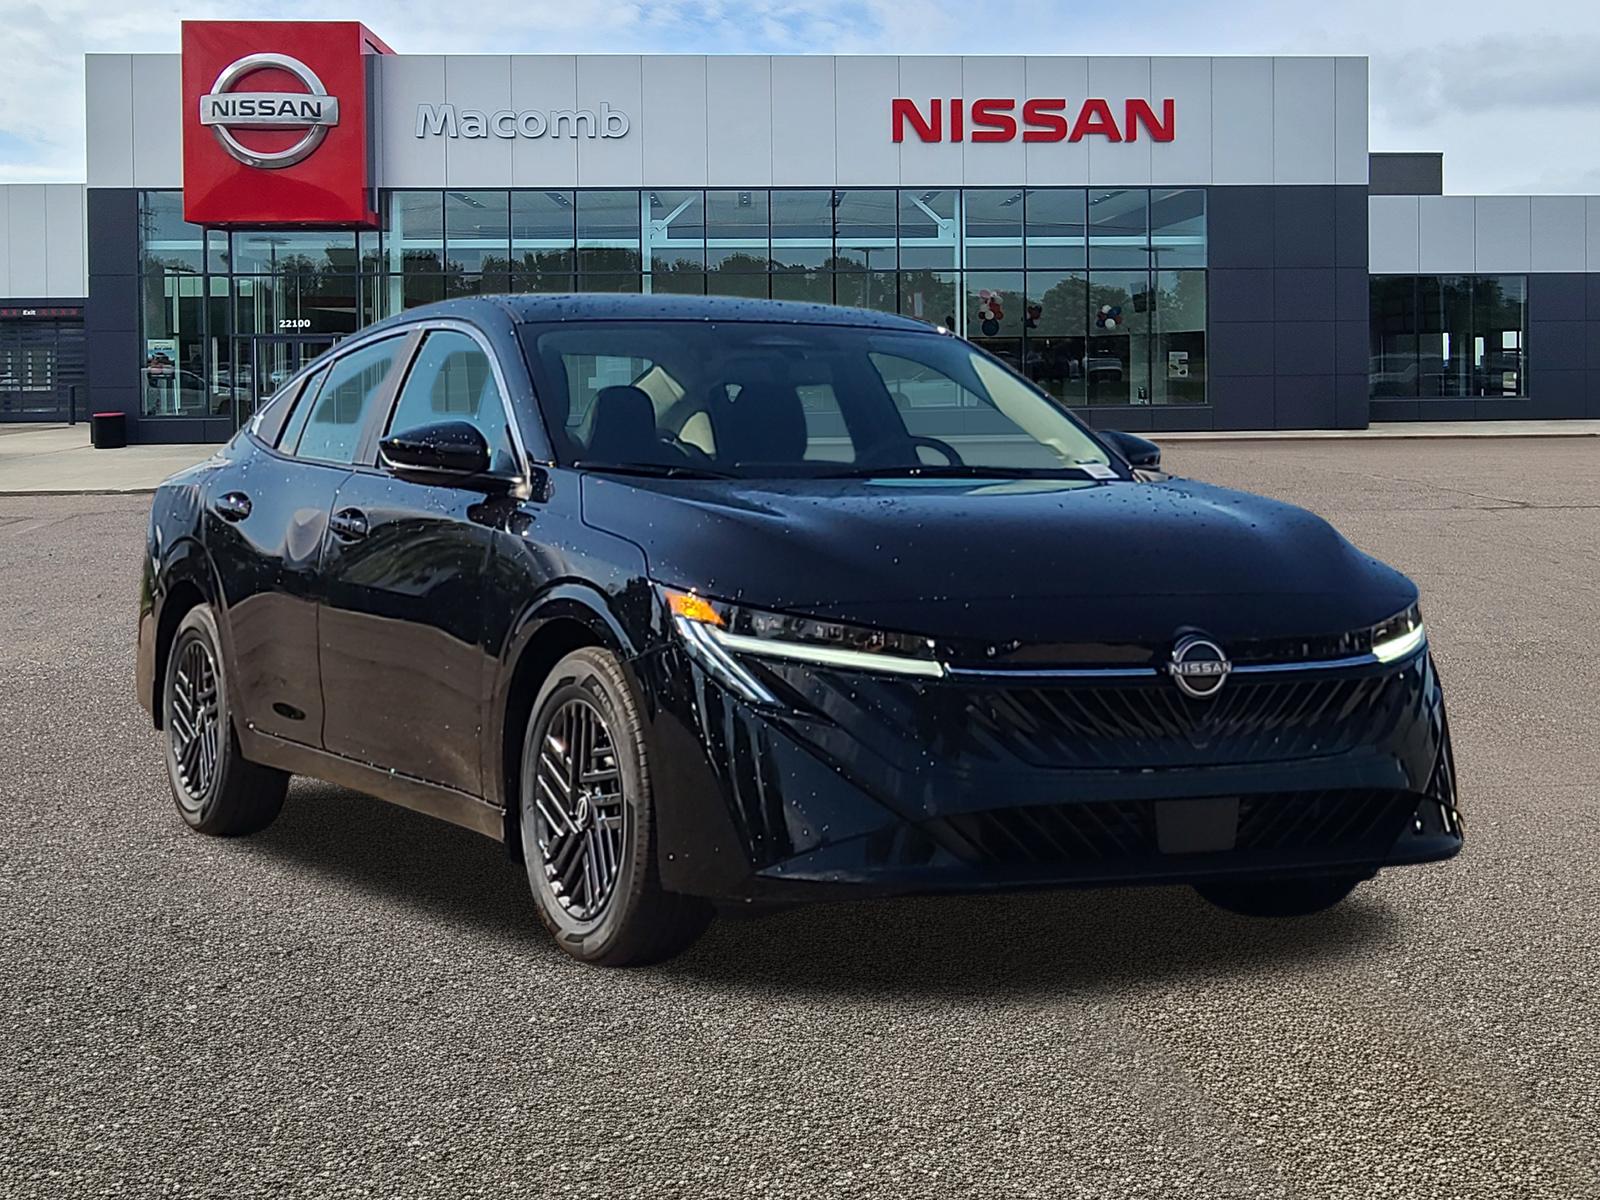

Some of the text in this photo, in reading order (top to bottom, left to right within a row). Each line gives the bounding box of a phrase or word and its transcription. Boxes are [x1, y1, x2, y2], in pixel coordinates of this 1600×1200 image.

[211, 100, 321, 117] NISSAN
[415, 102, 629, 138] Macomb
[892, 98, 1175, 142] NISSAN
[279, 319, 311, 328] 22100
[1168, 662, 1232, 675] NISSAN
